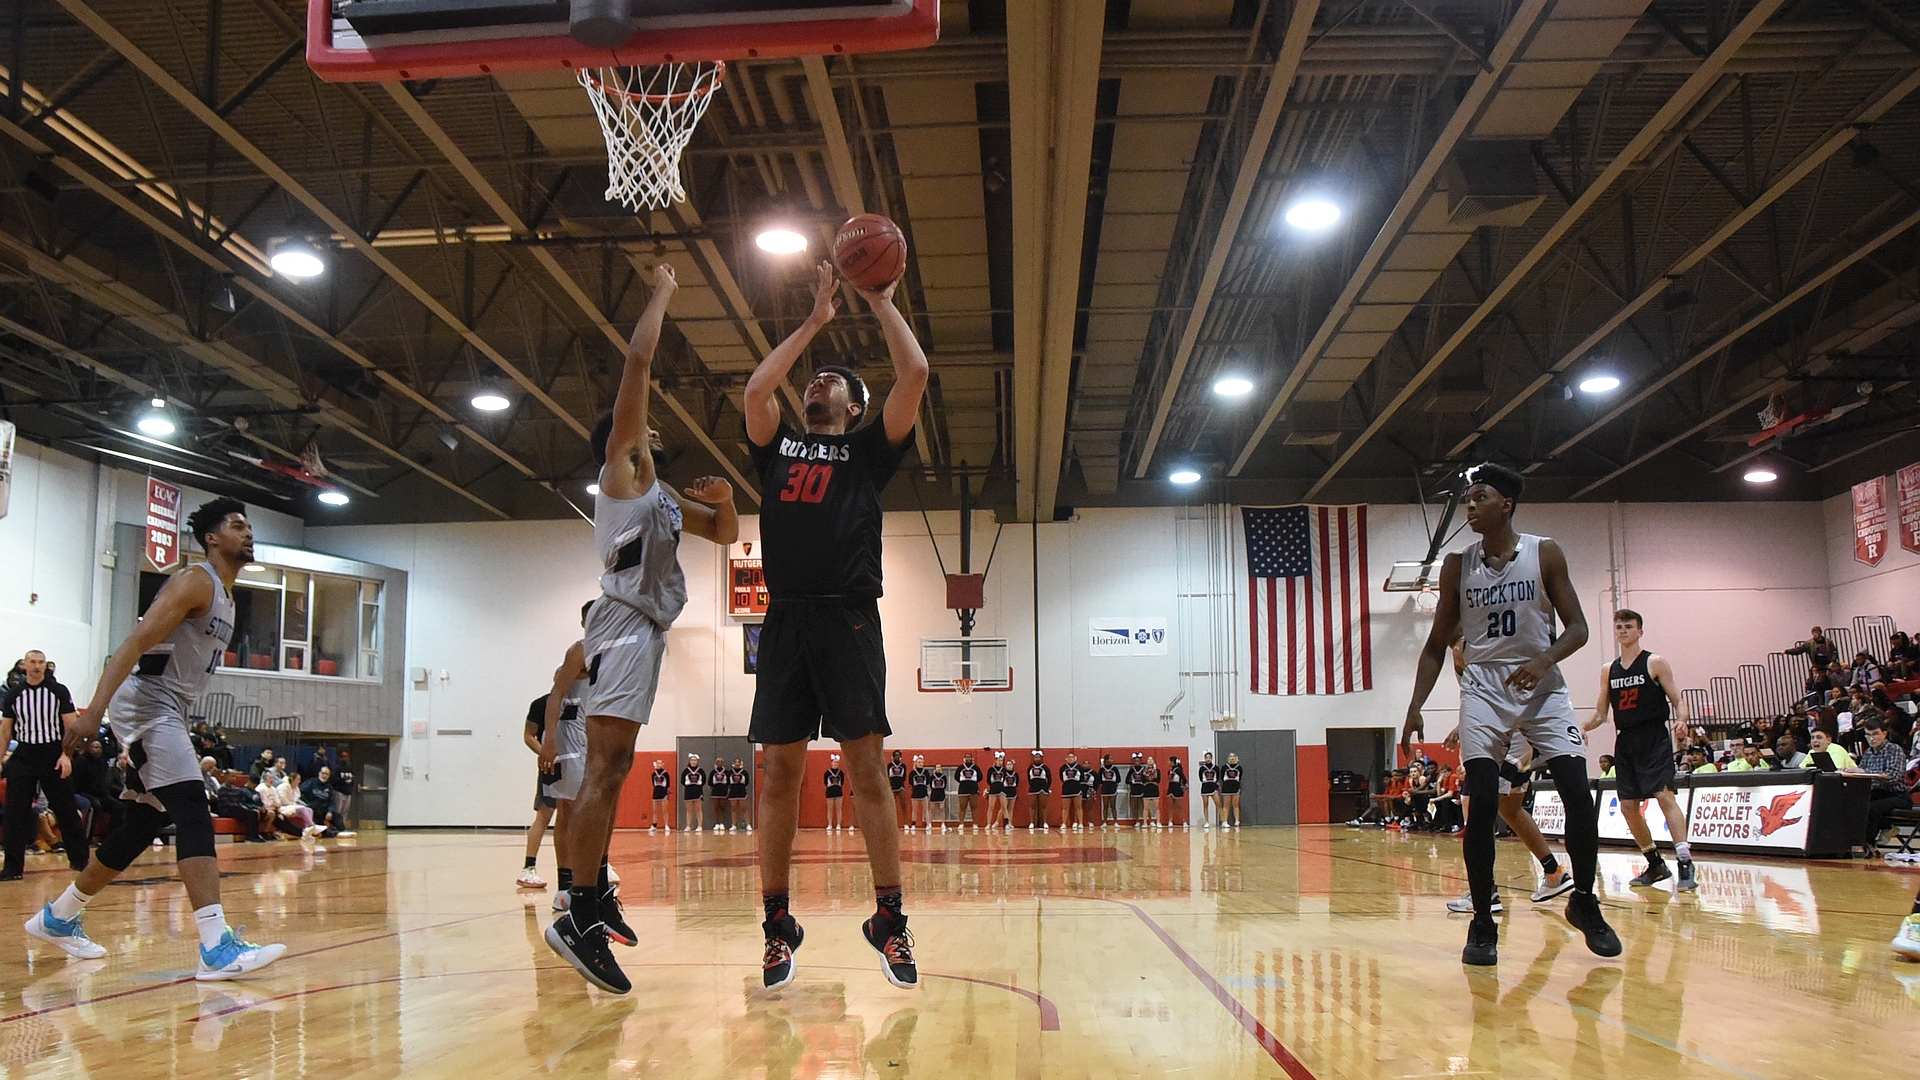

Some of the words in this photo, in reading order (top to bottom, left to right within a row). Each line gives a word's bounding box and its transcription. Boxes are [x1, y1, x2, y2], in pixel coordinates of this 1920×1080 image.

[779, 437, 849, 461] RUTGERS
[780, 462, 834, 504] 30
[150, 529, 173, 547] 2003
[154, 546, 167, 564] R
[1868, 543, 1878, 559] R
[758, 593, 767, 605] 4
[1466, 579, 1536, 609] STOCKTON
[1487, 609, 1516, 638] 20
[1092, 635, 1130, 645] Horizon
[1618, 688, 1639, 710] 22
[1700, 793, 1721, 803] HOME
[1723, 793, 1734, 803] OF
[1735, 792, 1751, 803] THE
[1533, 805, 1559, 817] RUTGERS
[1695, 806, 1753, 821] SCARLET
[1555, 819, 1564, 830] AT
[1692, 823, 1751, 839] RAPTORS
